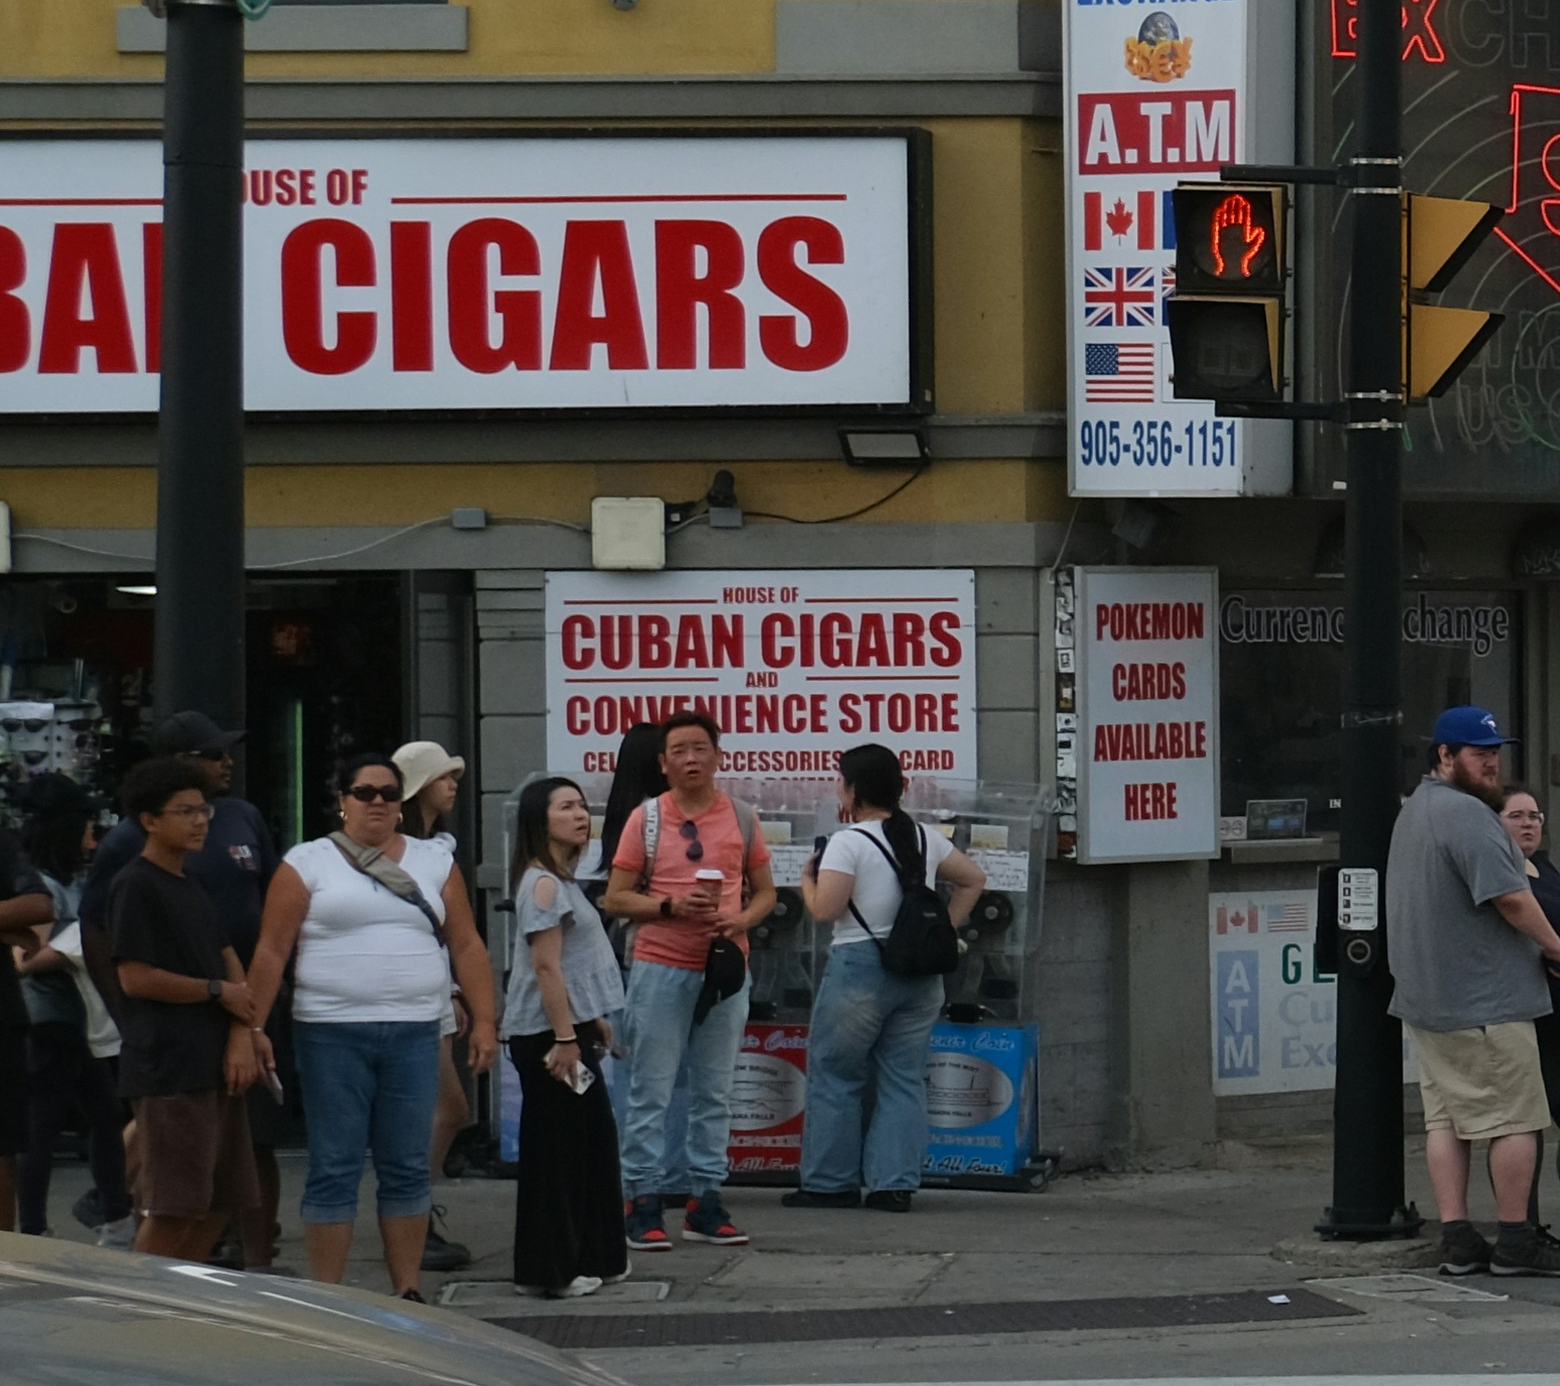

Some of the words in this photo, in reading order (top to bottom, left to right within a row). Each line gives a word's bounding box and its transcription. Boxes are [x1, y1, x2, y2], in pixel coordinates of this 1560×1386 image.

[1084, 100, 1232, 167] A.T.M
[245, 170, 316, 205] USE
[326, 170, 368, 205] OF
[281, 215, 850, 375] CIGARS
[1079, 418, 1238, 469] 905-356-1151
[723, 586, 776, 605] HOUSE
[780, 586, 800, 604] OF
[561, 614, 744, 671] CUBAN
[760, 610, 963, 669] CIGARS
[1096, 601, 1204, 641] POKEMON
[1222, 594, 1344, 645] Currenc
[1401, 592, 1510, 656] change
[746, 671, 778, 689] AND
[1111, 661, 1187, 702] CARDS
[838, 692, 960, 734] STORE
[719, 750, 840, 772] CCESSORIES
[1093, 720, 1207, 762] AVAILABLE
[1124, 781, 1178, 822] HERE
[1224, 960, 1253, 1069] ATM
